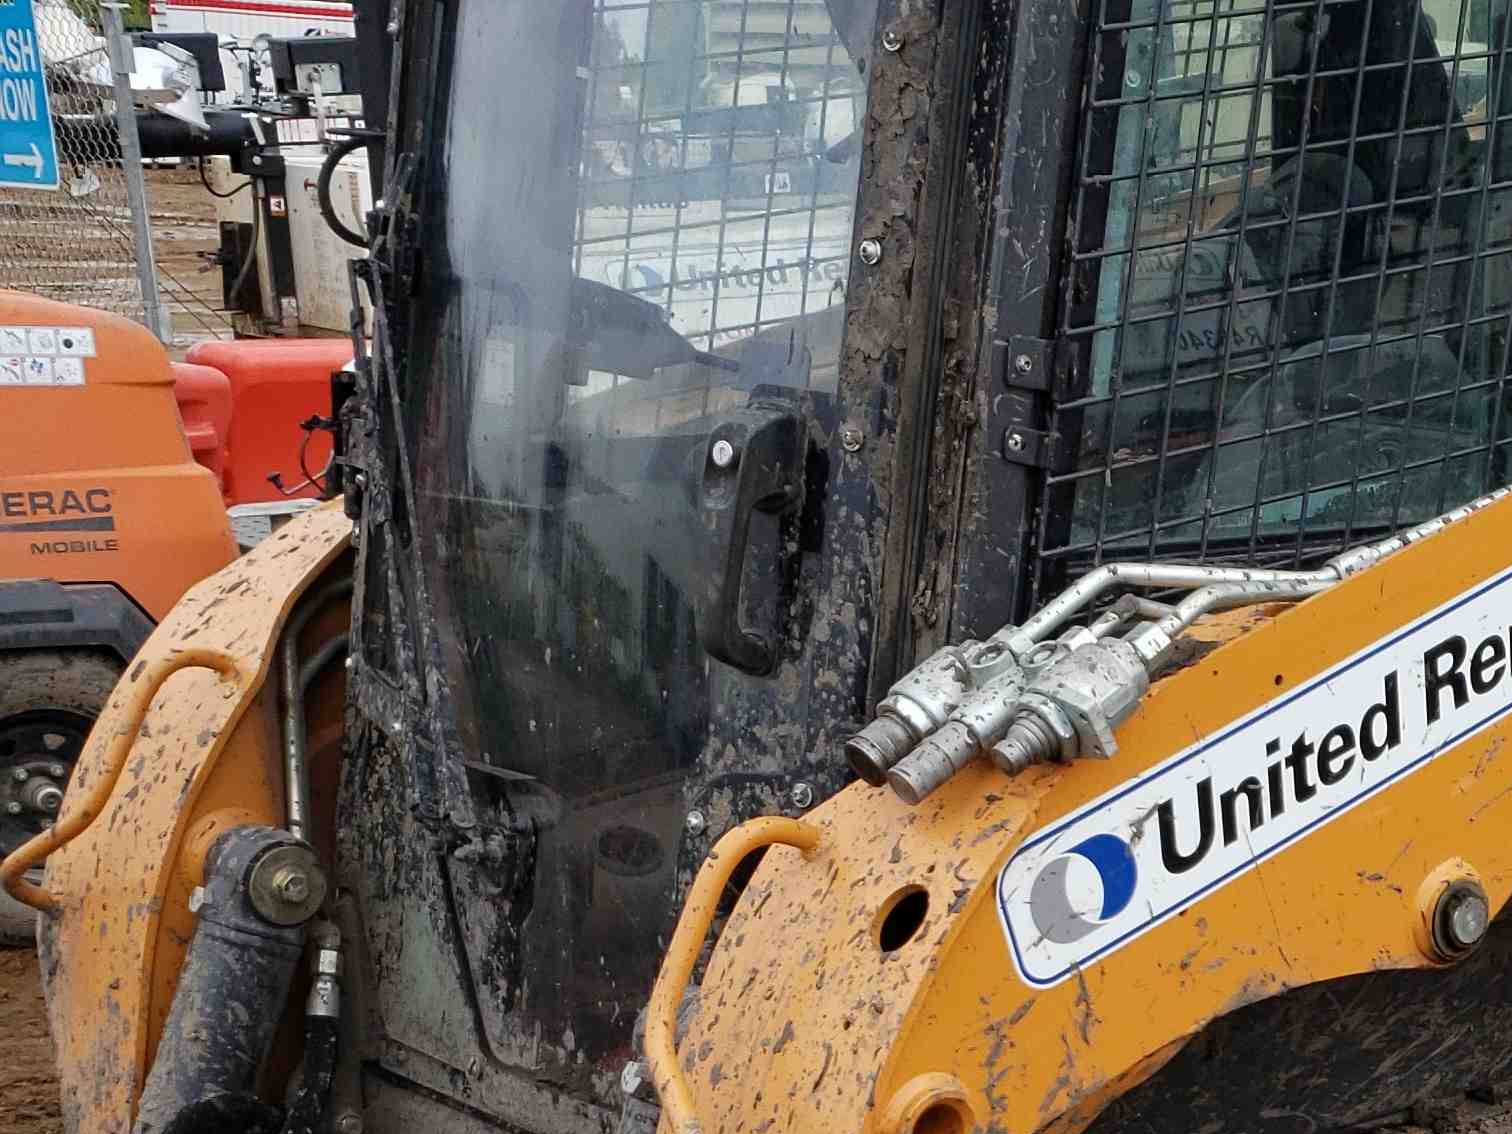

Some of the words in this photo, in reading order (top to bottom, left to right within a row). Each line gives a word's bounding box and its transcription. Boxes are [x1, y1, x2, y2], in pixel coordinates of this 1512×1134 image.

[0, 488, 112, 517] ERAC
[30, 539, 121, 555] MOBILE
[1156, 671, 1402, 876] United
